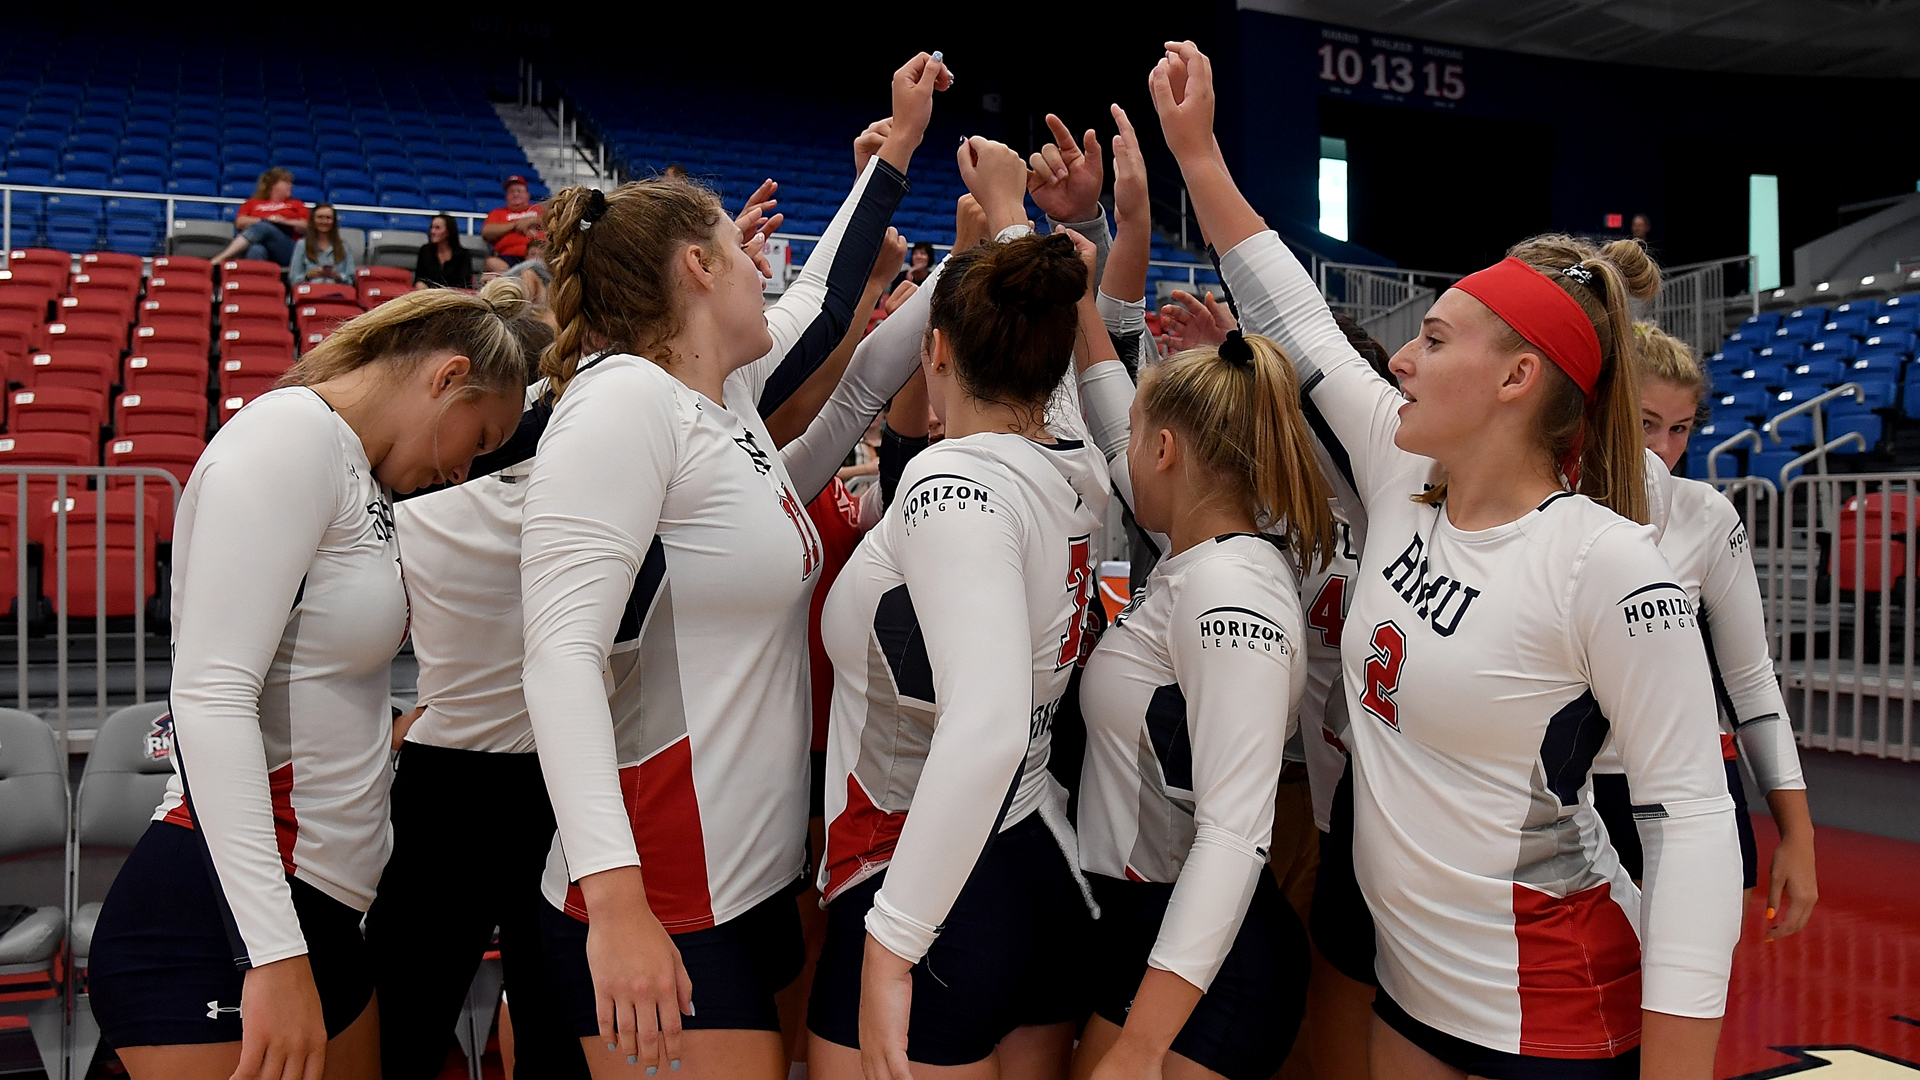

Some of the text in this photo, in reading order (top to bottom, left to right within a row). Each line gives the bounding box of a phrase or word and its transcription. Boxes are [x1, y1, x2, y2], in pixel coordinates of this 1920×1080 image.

[1318, 43, 1364, 86] 10
[1370, 52, 1415, 94] 13
[1422, 60, 1466, 100] 15
[903, 485, 988, 525] HORIZON
[906, 501, 988, 537] LEAGUE
[1202, 638, 1285, 655] LEAGUE
[1628, 617, 1695, 637] LEAGU
[1359, 620, 1407, 733] 2
